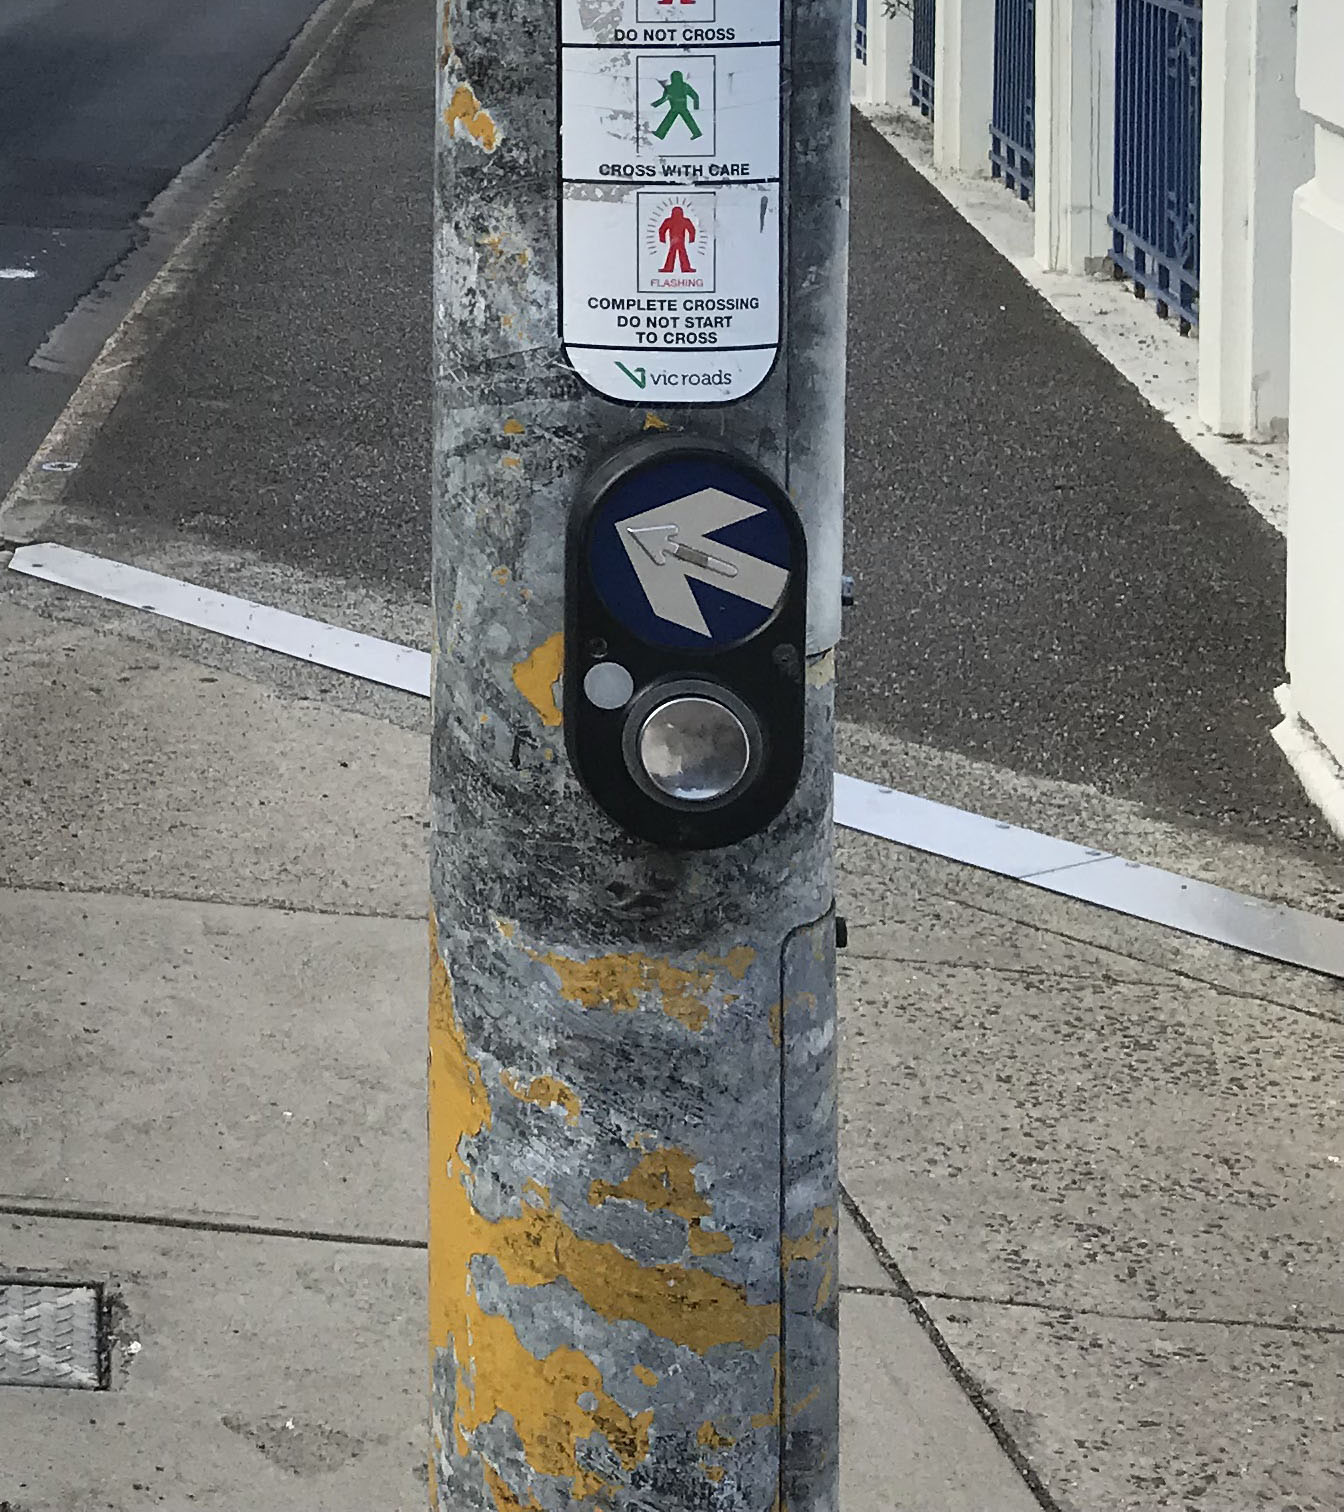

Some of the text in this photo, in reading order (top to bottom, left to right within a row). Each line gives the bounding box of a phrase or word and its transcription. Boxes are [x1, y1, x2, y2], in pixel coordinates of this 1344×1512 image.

[614, 28, 736, 42] DO NOT CROSS
[599, 163, 750, 177] CROSS WITH CARE
[650, 277, 704, 288] FLASHING
[587, 297, 759, 311] COMPLETE CROSSING
[617, 315, 733, 328] DO NOT START
[636, 332, 718, 344] TO CROSS
